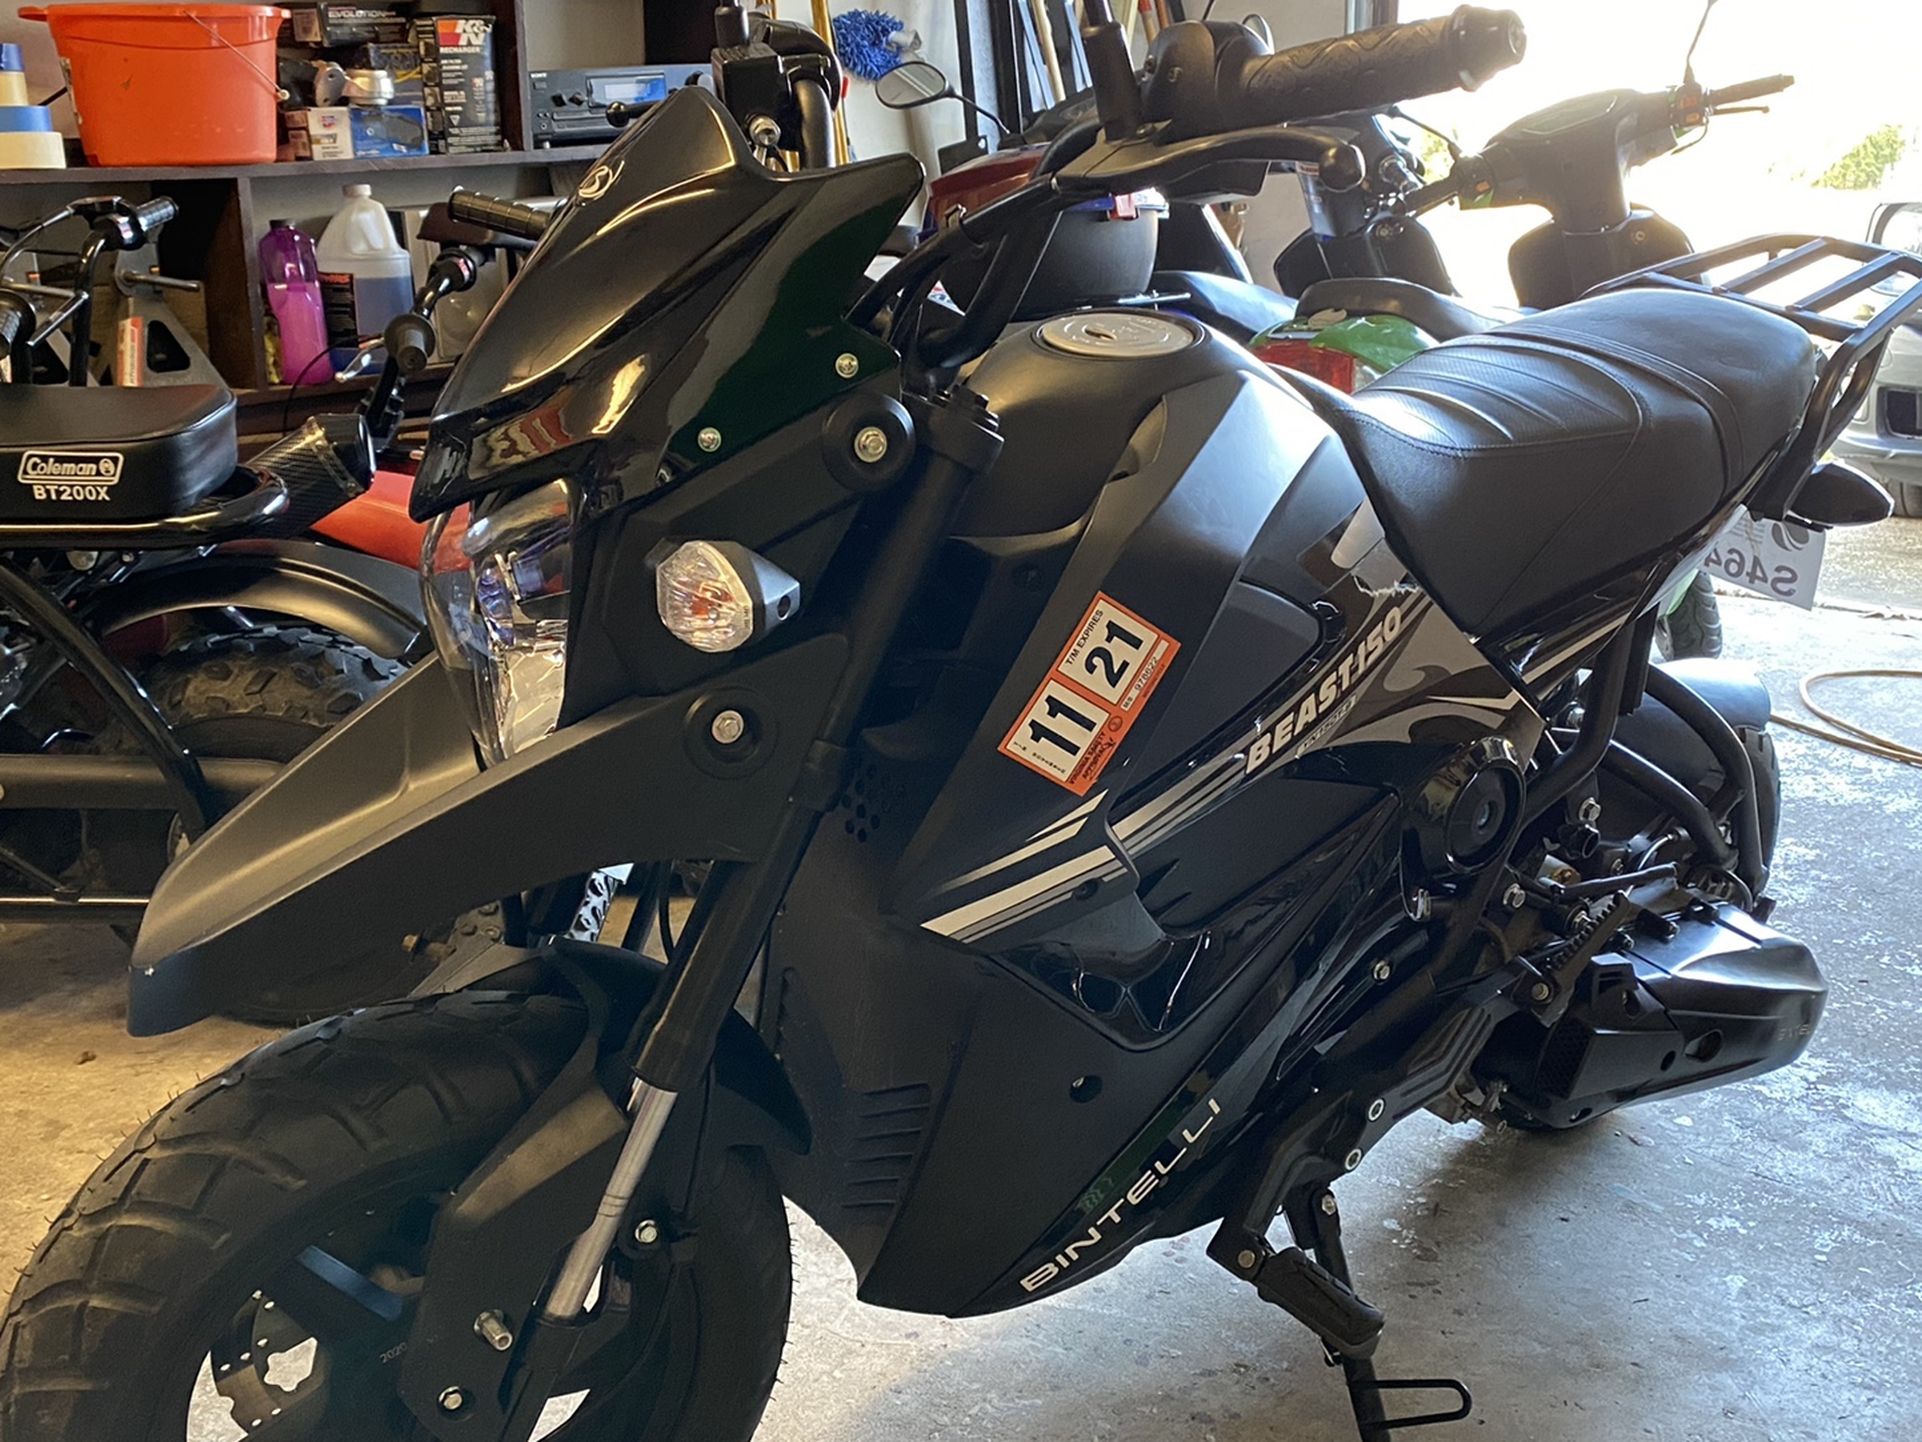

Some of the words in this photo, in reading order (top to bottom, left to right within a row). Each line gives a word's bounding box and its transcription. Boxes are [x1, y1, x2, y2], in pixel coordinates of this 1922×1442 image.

[26, 457, 97, 476] Coleman
[32, 484, 110, 501] BT200X
[1065, 649, 1080, 666] T/M
[1077, 609, 1104, 649] EXPIRES
[1084, 619, 1144, 689] 21
[1027, 694, 1098, 757] 11
[1019, 1098, 1221, 1292] BINTELLI
